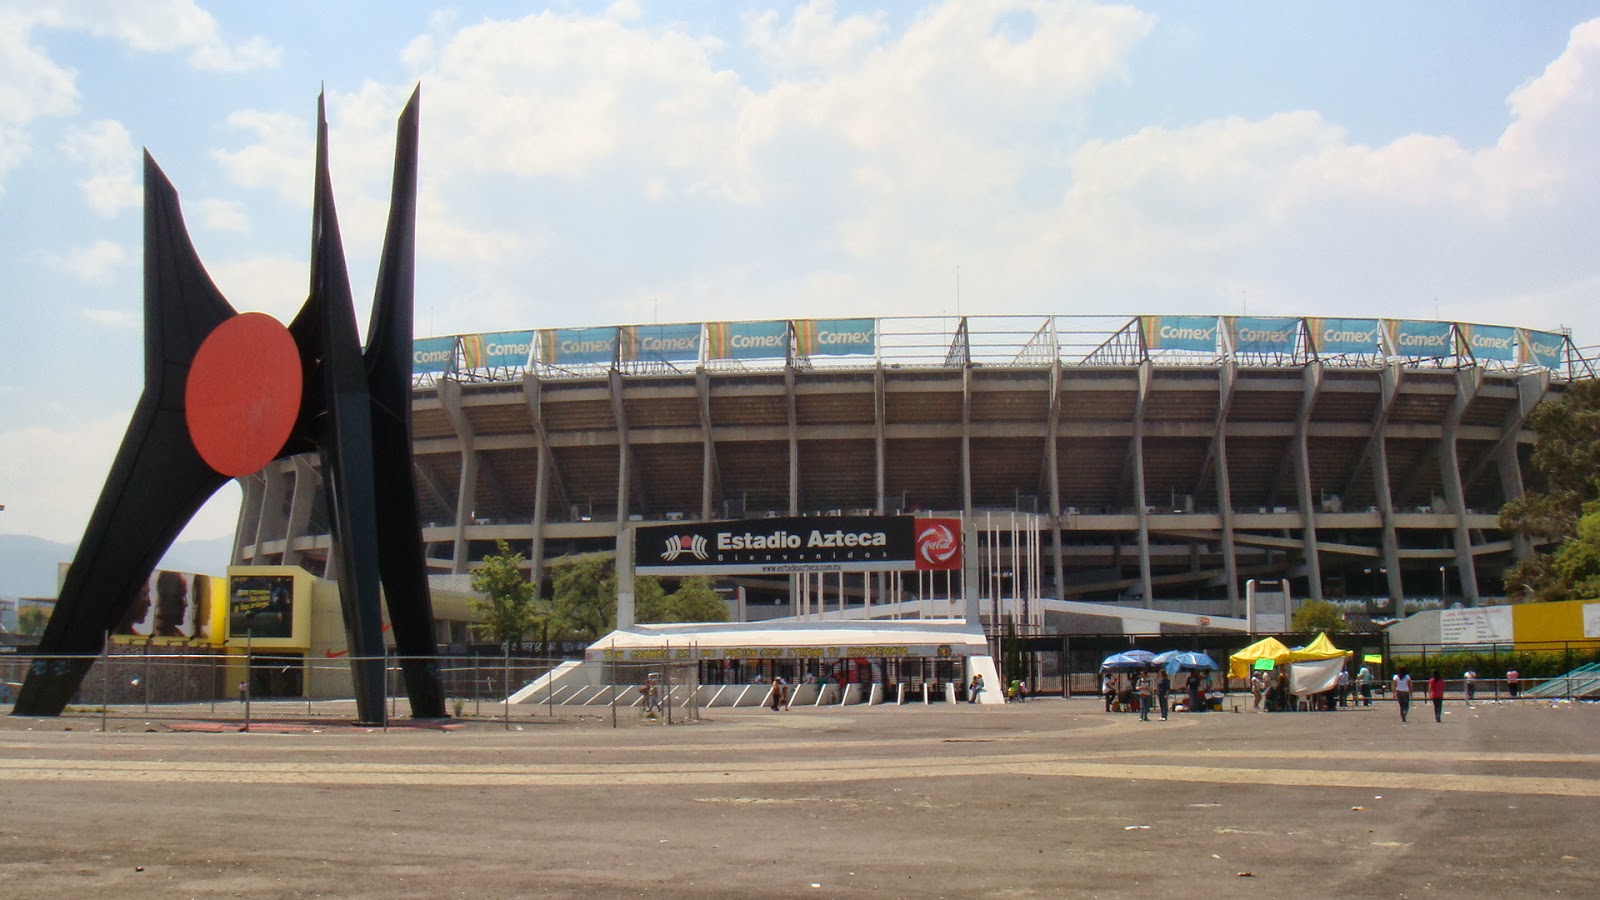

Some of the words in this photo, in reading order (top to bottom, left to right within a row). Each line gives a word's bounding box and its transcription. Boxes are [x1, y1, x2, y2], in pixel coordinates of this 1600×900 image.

[731, 332, 786, 348] Comex
[818, 329, 873, 345] Comex
[1160, 326, 1216, 341] Comex
[1239, 328, 1293, 343] Comex
[1324, 329, 1376, 343] Comex
[1399, 332, 1449, 347] Comex
[561, 336, 616, 354] Comex
[641, 335, 699, 352] Comex
[1472, 334, 1513, 349] Comex
[717, 531, 801, 550] Estadio
[807, 529, 887, 548] Azteca
[717, 551, 887, 562] Bienvenidos
